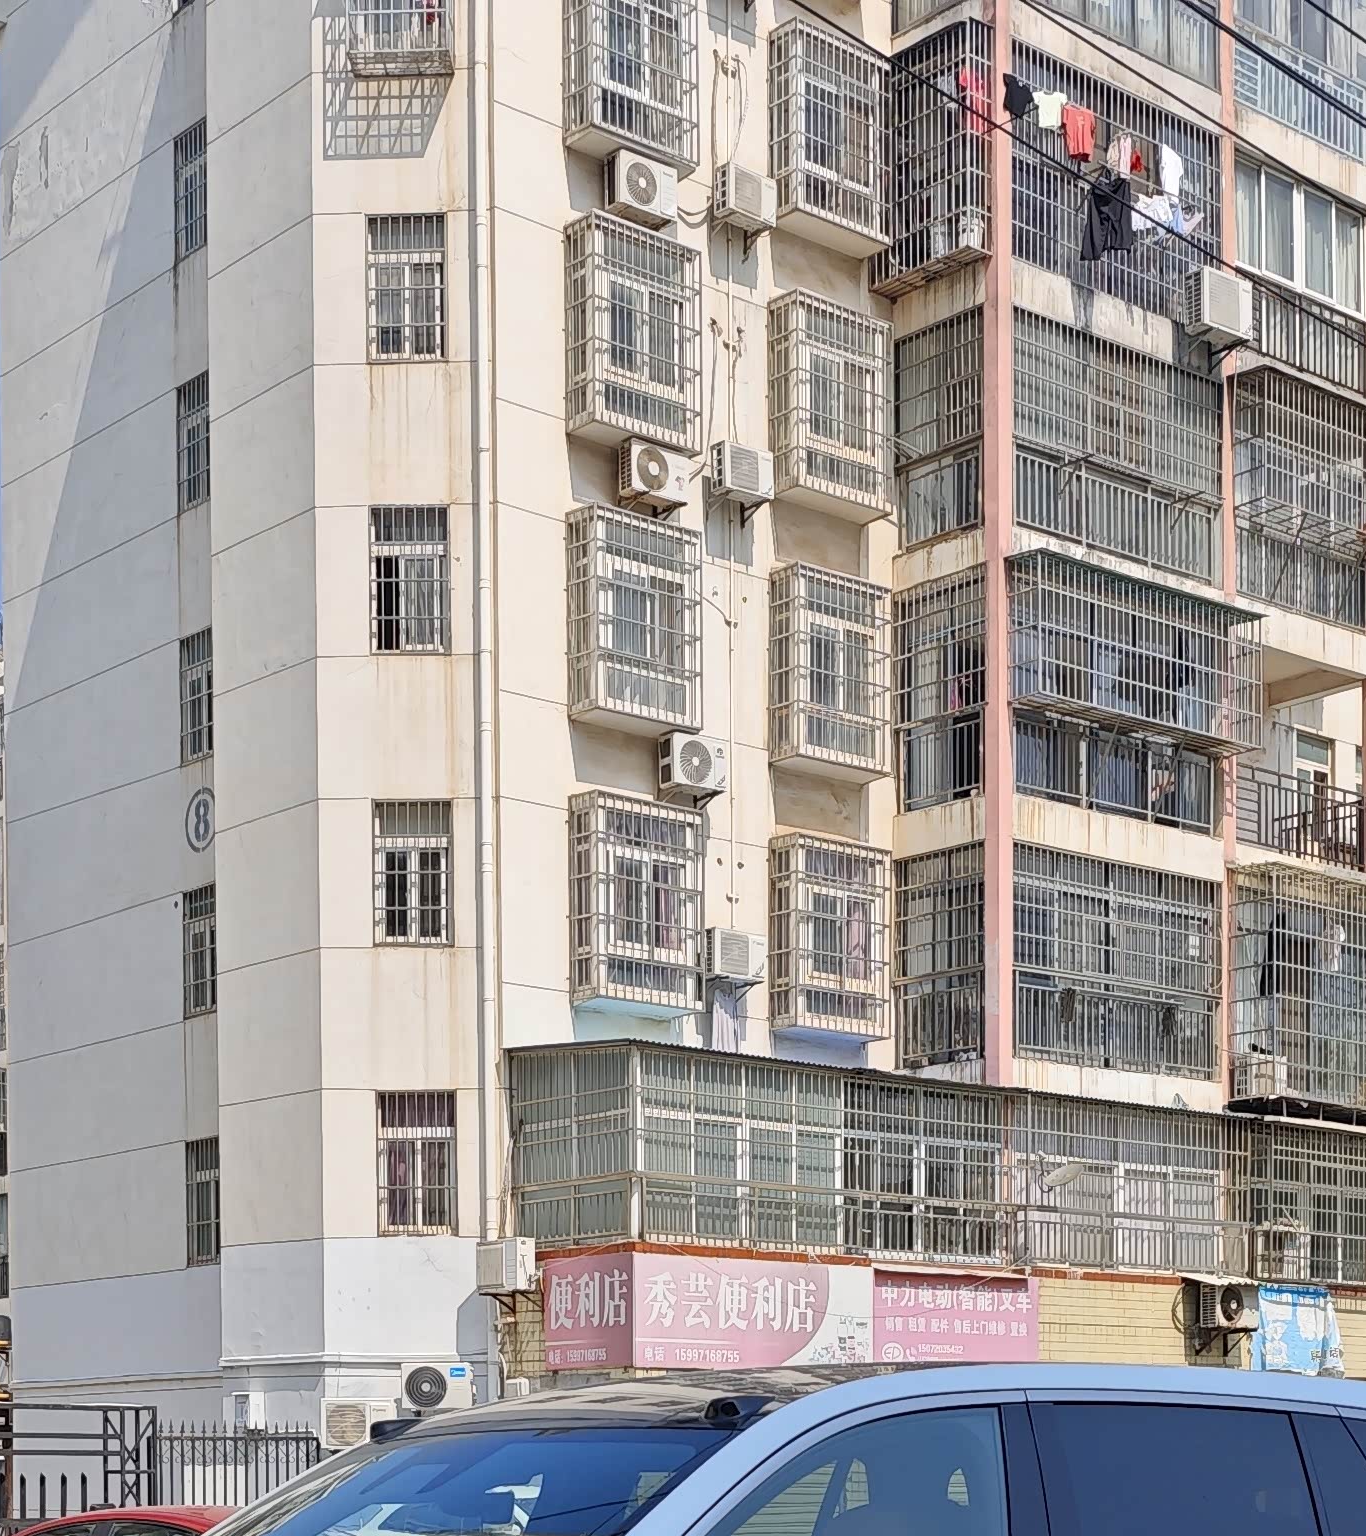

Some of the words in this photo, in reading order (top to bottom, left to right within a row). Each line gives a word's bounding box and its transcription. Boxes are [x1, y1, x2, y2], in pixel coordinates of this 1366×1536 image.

[548, 1268, 627, 1330] 便利店
[643, 1270, 817, 1333] 秀芸便利店
